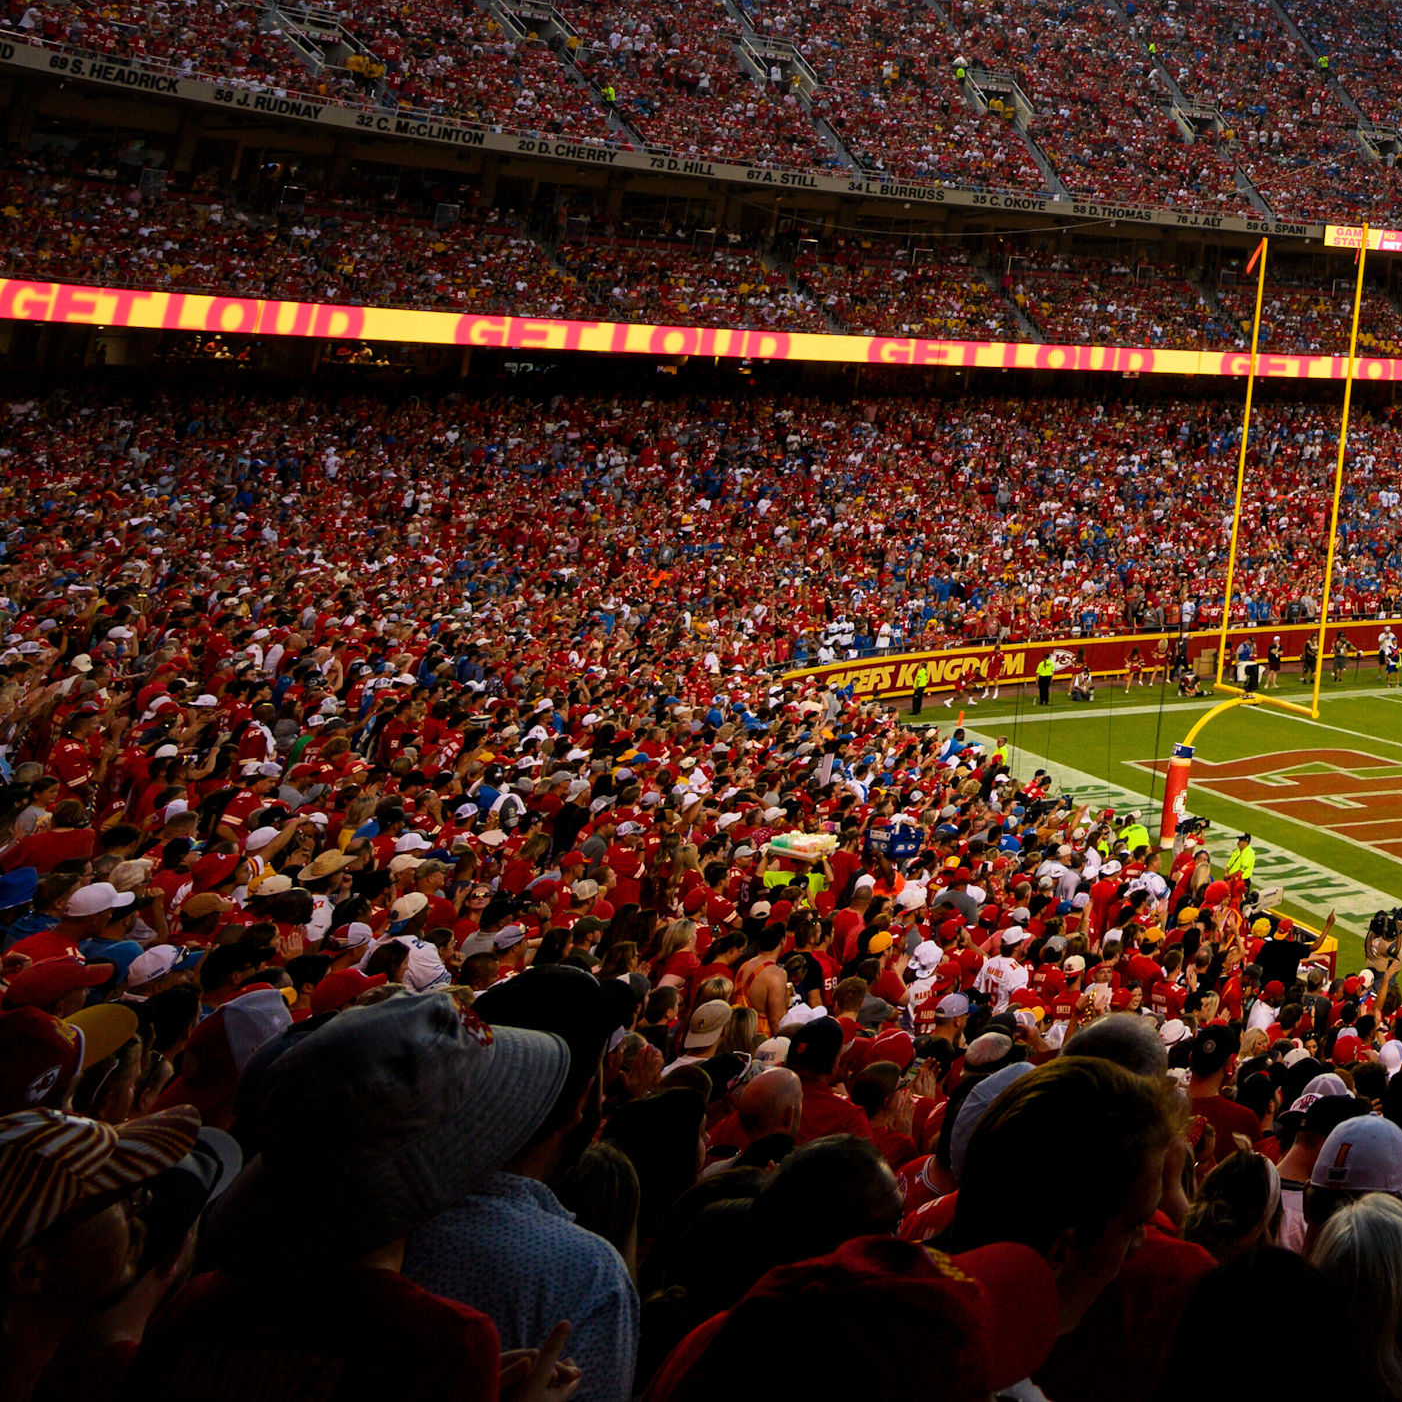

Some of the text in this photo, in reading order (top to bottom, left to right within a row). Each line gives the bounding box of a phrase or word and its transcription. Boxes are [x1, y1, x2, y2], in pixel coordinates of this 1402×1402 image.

[49, 54, 179, 94] 69 S. HEADRICK
[213, 89, 323, 120] 58 J. RUDNAY
[356, 114, 374, 128] 32
[376, 117, 392, 132] C.
[517, 139, 618, 163] 20 D. CHERRY
[649, 156, 715, 176] 73 D. HILL
[746, 169, 818, 188] 67 A. STILL
[847, 181, 945, 201] 34 L. BURRUSS
[972, 194, 1047, 211] 35 C. OKOYE
[1073, 204, 1152, 221] 58 D. THOMAS
[1190, 215, 1223, 228] J. ALT
[1246, 221, 1307, 236] 59 G. SPANI
[1336, 228, 1369, 237] GAM
[0, 279, 366, 339] GET LOUD
[454, 313, 790, 358] GET LOUD
[867, 337, 1155, 373] GET LOUD
[1220, 352, 1322, 378] GET
[896, 652, 1026, 687] KNGDM
[824, 976, 839, 991] 58
